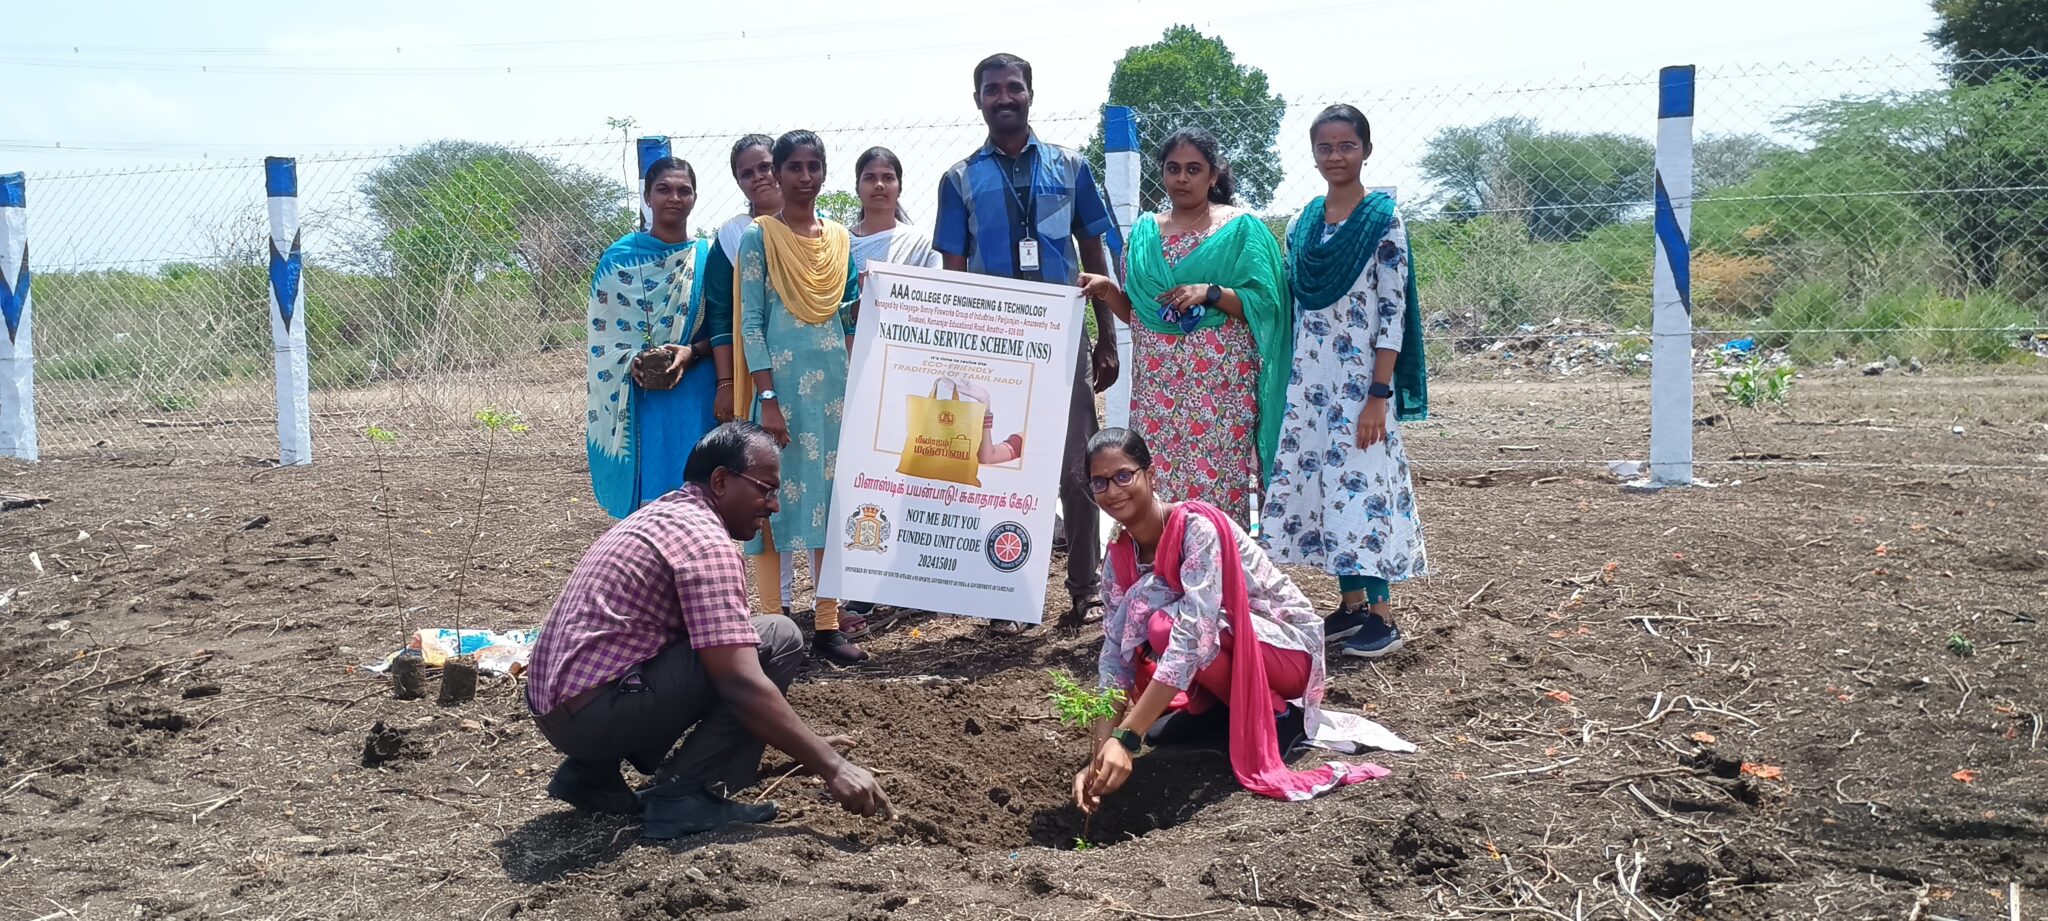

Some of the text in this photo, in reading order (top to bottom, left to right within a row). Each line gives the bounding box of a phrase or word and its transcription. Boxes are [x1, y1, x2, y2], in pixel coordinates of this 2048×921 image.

[889, 282, 1048, 318] AAA COLLEGE OF ENGINEERING & TECHNOLOGY
[874, 299, 893, 310] Managed
[893, 301, 898, 311] by
[934, 307, 954, 317] Fireworks
[955, 310, 968, 320] Group
[974, 312, 994, 322] Industries
[1050, 322, 1060, 330] Trust
[949, 320, 973, 330] Educational
[880, 322, 1052, 363] NATIONAL SERVICE SCHEME (NSS)
[893, 364, 1023, 386] TRADITION OF TAMIL NADU
[922, 360, 994, 374] ECO-FRIENDLY
[854, 472, 905, 498] பிளாஸ்டிக்
[906, 483, 959, 506] பயன்பாடு!
[959, 492, 1007, 510] சுகாதாரக்
[906, 508, 980, 530] NOT ME BUT YOU
[897, 529, 981, 552] FUNDED UNIT CODE
[918, 554, 958, 571] 202415010
